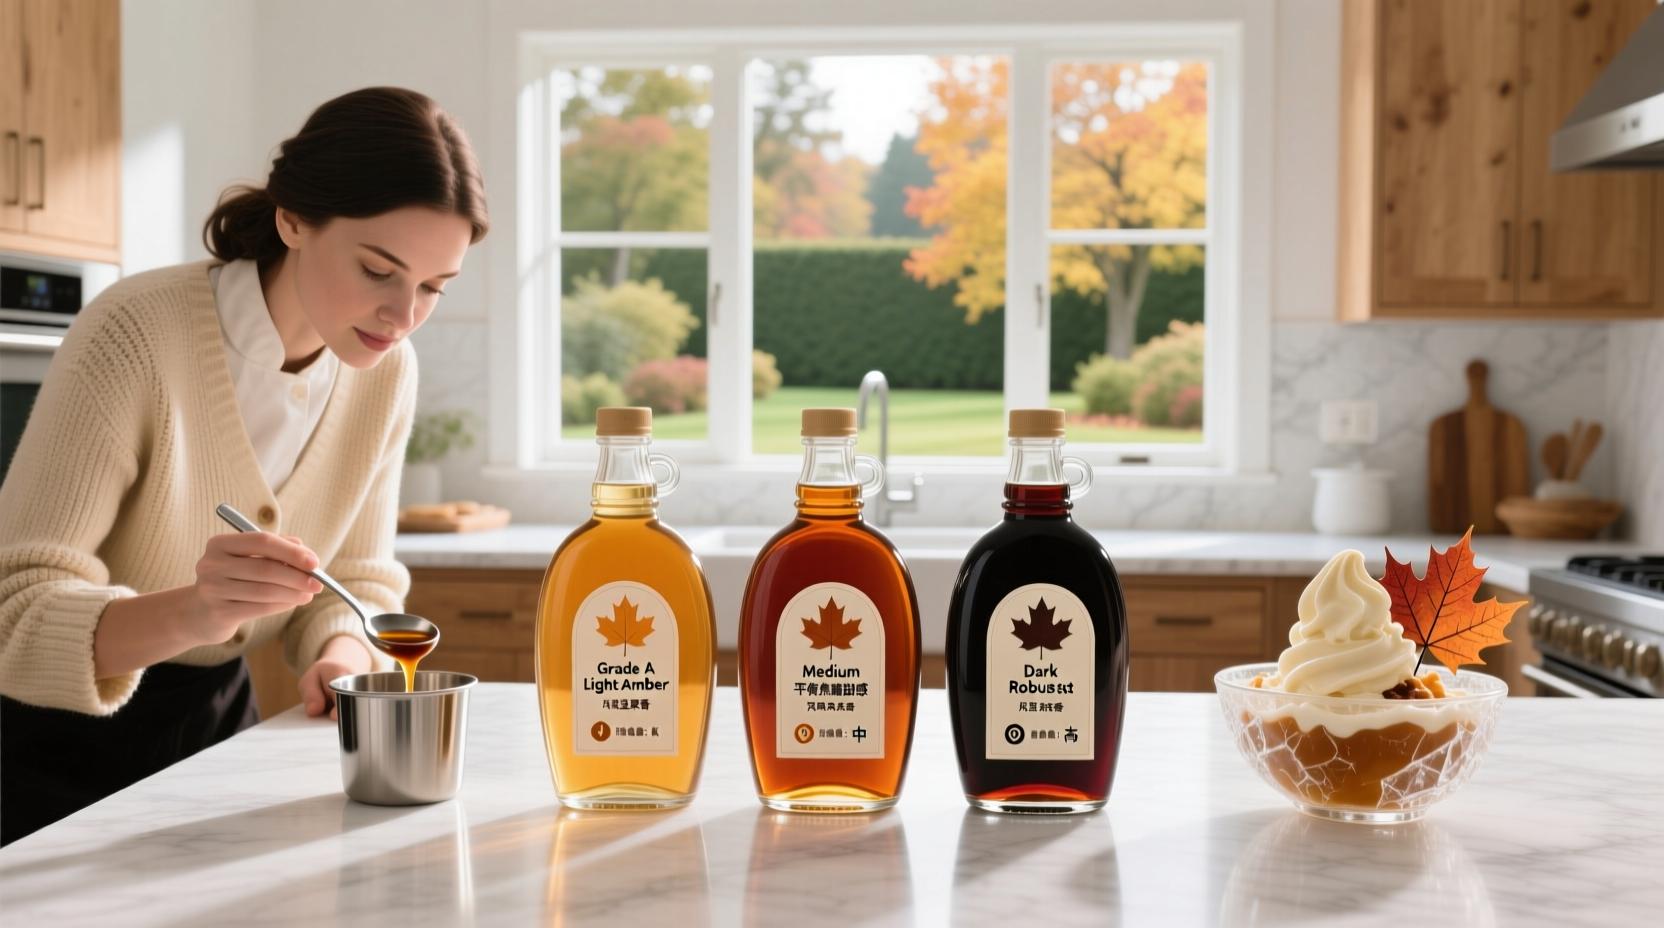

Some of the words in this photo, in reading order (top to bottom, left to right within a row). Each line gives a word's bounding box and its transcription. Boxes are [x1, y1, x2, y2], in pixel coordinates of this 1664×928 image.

[597, 661, 640, 674] Grade
[644, 661, 656, 674] A
[802, 664, 861, 678] Medium
[1024, 663, 1059, 678] Dark
[584, 677, 619, 694] Light
[621, 677, 670, 690] Amber
